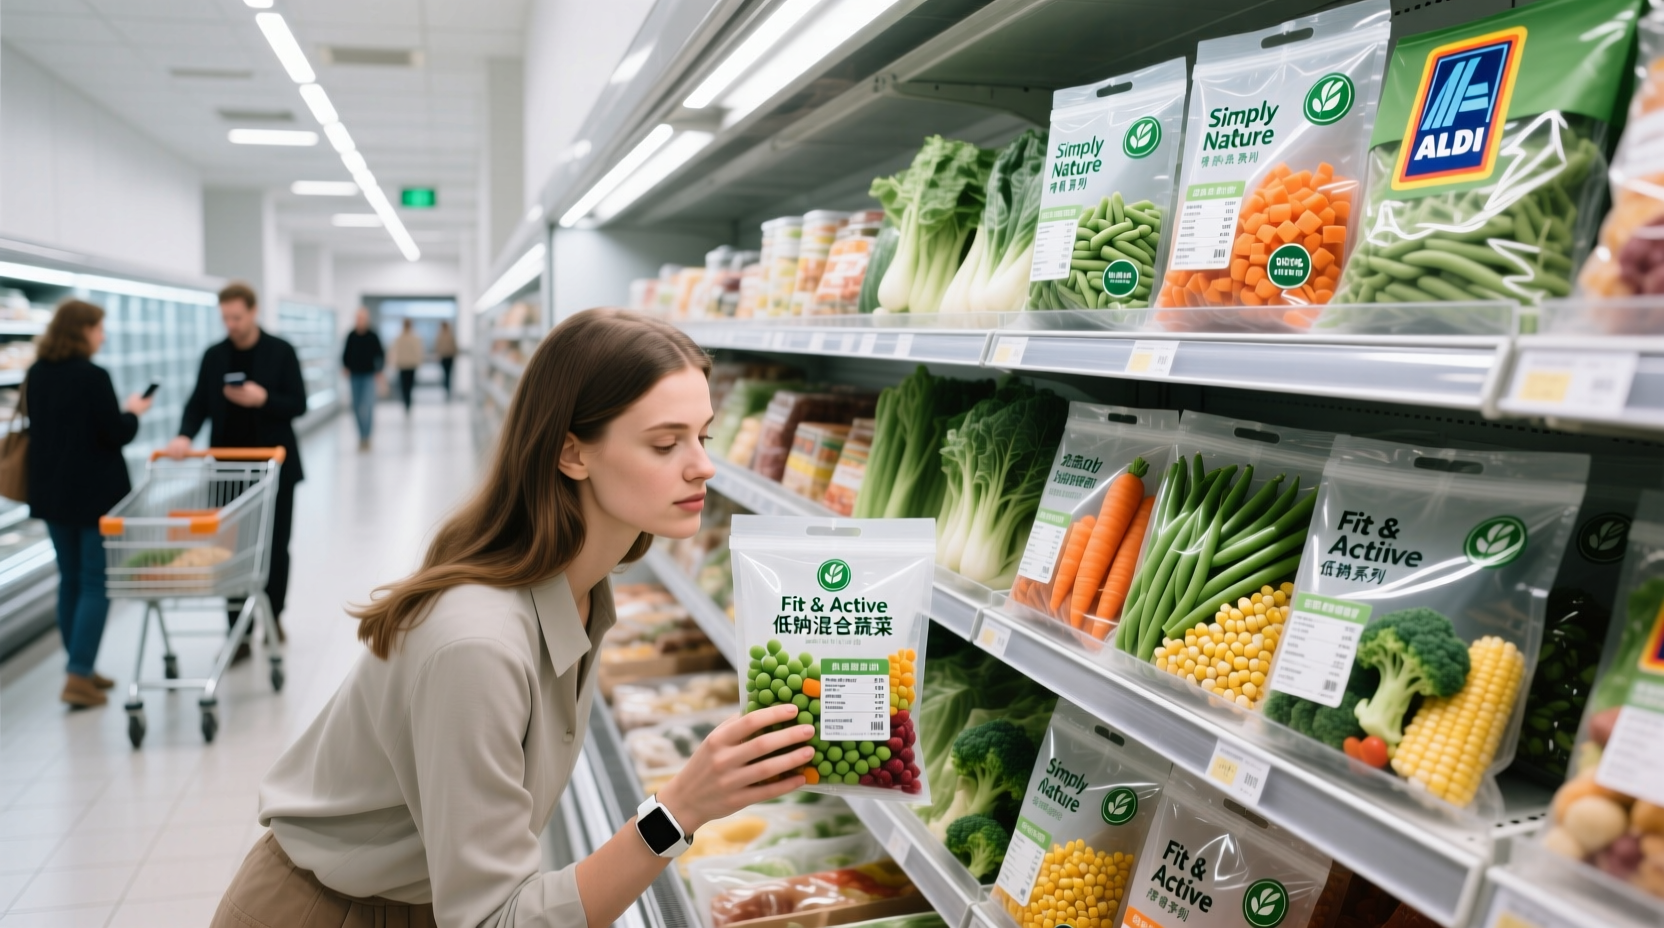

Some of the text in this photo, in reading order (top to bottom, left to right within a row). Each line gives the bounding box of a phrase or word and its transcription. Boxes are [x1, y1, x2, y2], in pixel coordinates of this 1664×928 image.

[1208, 100, 1279, 128] Simply
[1055, 135, 1104, 159] Simply
[1203, 128, 1275, 151] Nature
[1414, 127, 1485, 161] ALDI
[1051, 158, 1102, 179] Nature
[1337, 510, 1400, 541] Fit &
[781, 596, 888, 613] Fit & Active
[1046, 757, 1089, 795] Simply
[1037, 777, 1080, 813] Nature
[1162, 839, 1207, 882] Fit &
[1151, 864, 1213, 913] Active
